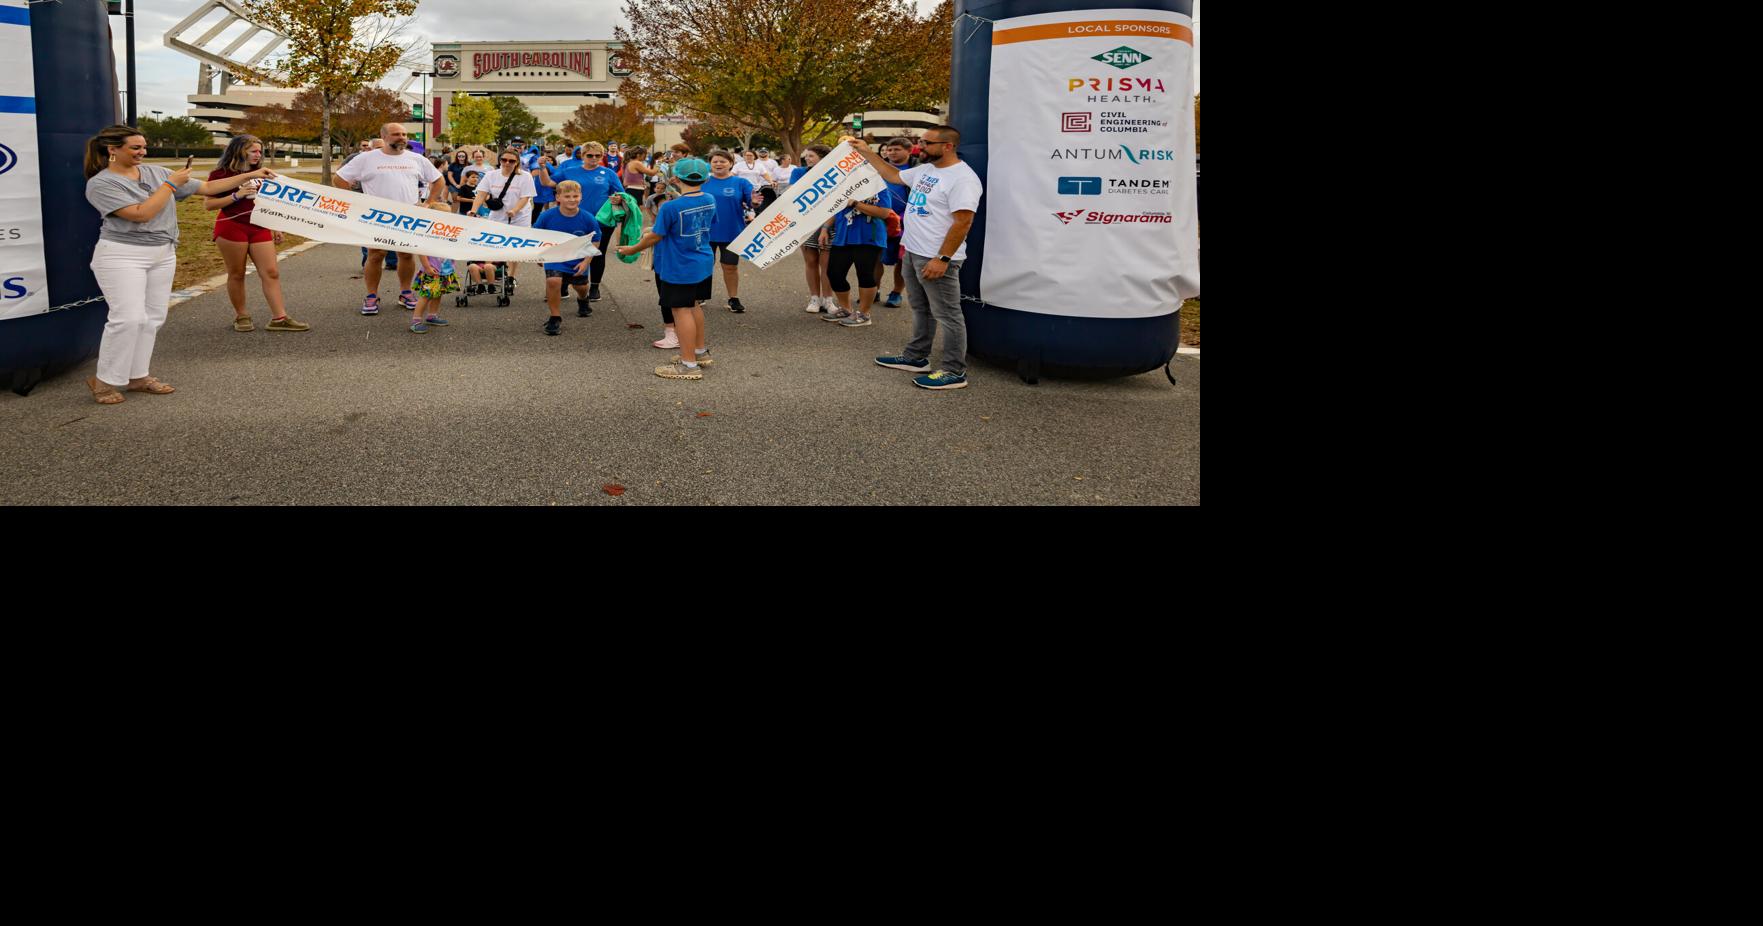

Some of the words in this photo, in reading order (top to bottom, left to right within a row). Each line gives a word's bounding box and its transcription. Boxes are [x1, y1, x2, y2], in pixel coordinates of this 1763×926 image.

[1068, 25, 1111, 34] LOCAL
[1114, 24, 1171, 34] SPONSORS
[473, 52, 520, 79] SOUTH
[522, 51, 593, 79] CAROLINA
[1101, 52, 1142, 64] SENN
[1068, 77, 1165, 92] PRISMA
[1051, 149, 1122, 160] ANTUM
[1139, 149, 1174, 161] RISK
[259, 178, 317, 204] DRF
[793, 167, 839, 213] JDRF
[1108, 179, 1169, 188] TANDEM
[319, 202, 349, 214] WALK
[360, 208, 431, 231] JDRF
[433, 222, 464, 234] ONE
[763, 212, 784, 233] ONE
[770, 216, 791, 236] WALK
[1086, 211, 1172, 225] Signarama
[471, 232, 540, 249] JDRF
